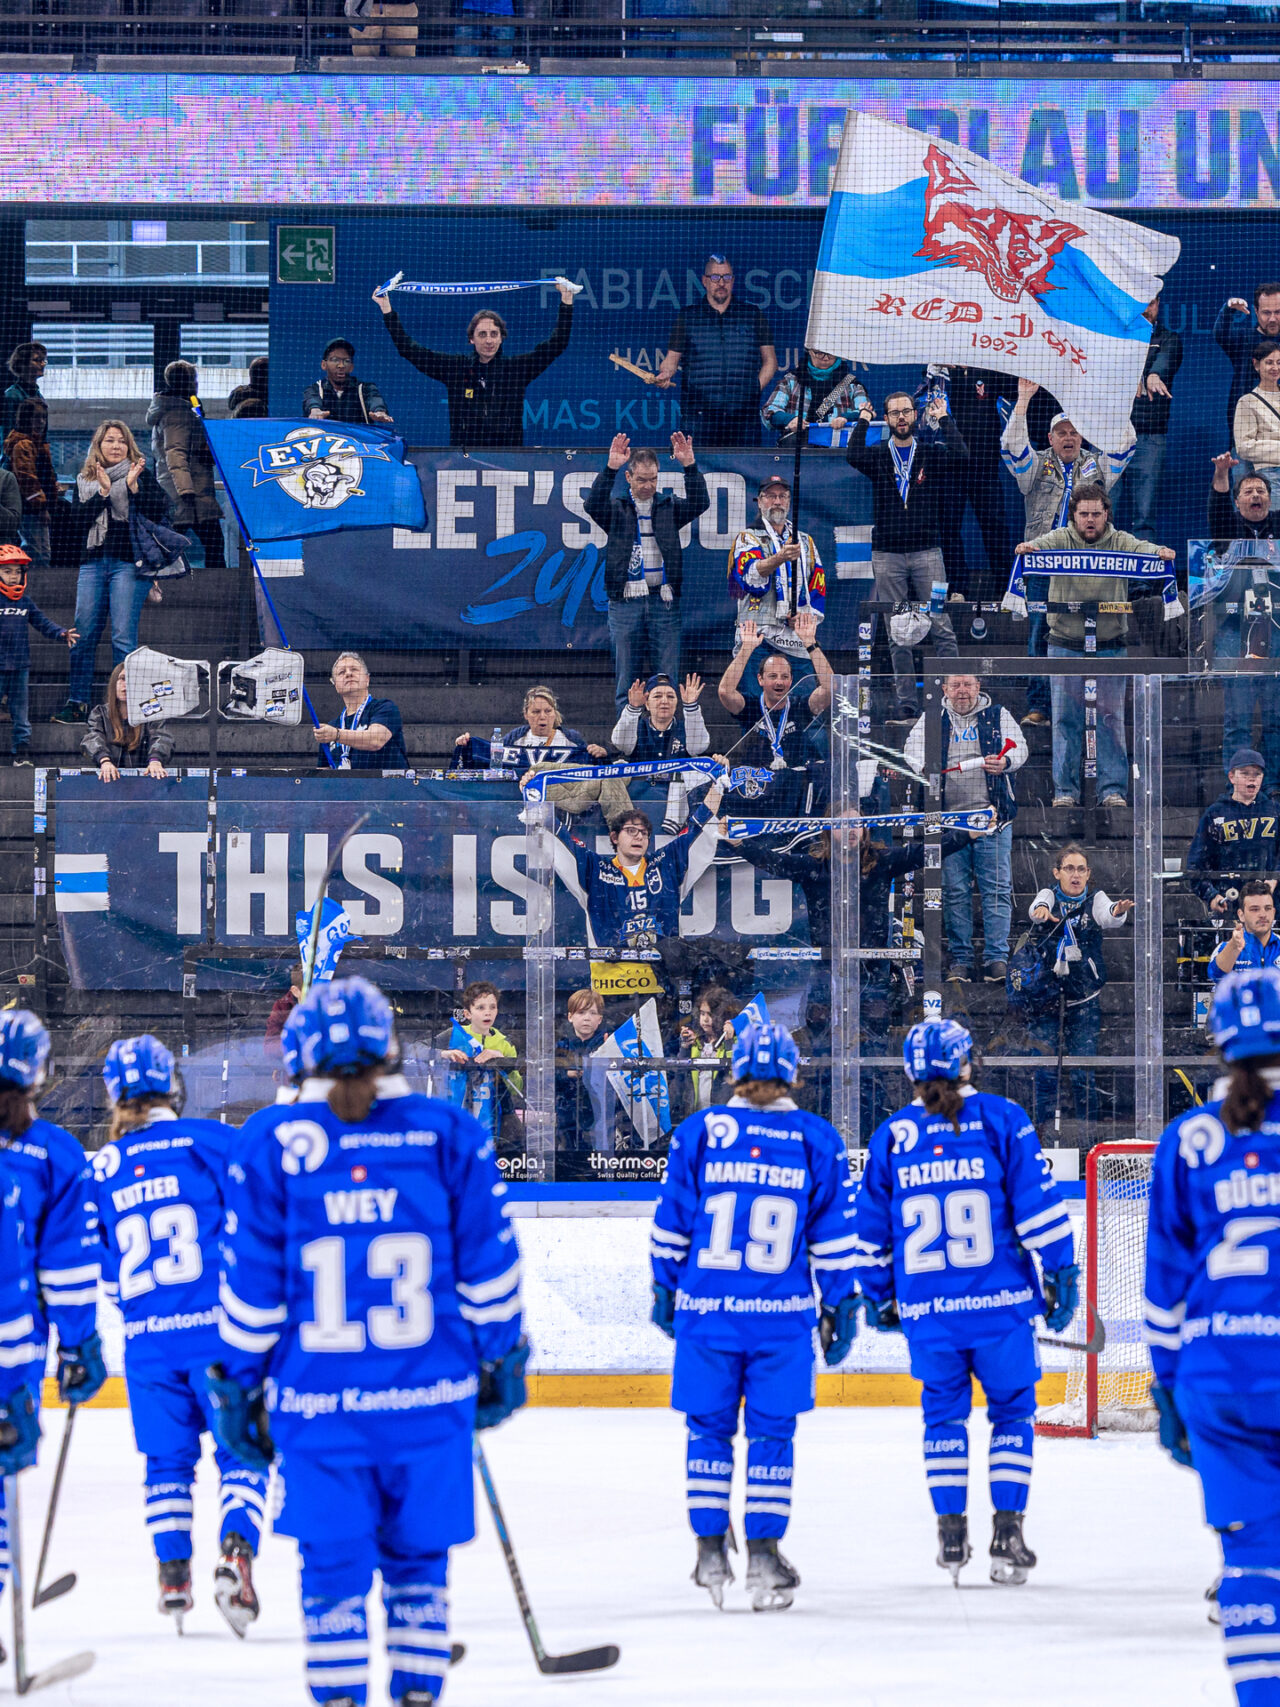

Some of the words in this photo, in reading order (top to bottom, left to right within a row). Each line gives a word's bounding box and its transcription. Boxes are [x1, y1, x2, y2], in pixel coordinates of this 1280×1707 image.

[970, 332, 1019, 357] 1992
[267, 436, 357, 469] EVZ
[1024, 552, 1138, 573] EISSPORTVEREIN
[1143, 558, 1166, 574] ZUG
[501, 745, 571, 767] EVZ
[597, 765, 621, 777] FÜR
[623, 763, 653, 775] BLAU
[1223, 816, 1276, 843] EVZ
[158, 832, 403, 936] THIS
[452, 834, 551, 936] IS
[629, 890, 648, 911] 15
[624, 915, 658, 936] EVZ
[593, 976, 651, 990] CHICCO
[746, 1125, 785, 1141] BEYOND
[597, 1171, 615, 1179] Swiss
[616, 1171, 639, 1180] Quality
[640, 1171, 661, 1179] Coffee
[704, 1161, 806, 1190] MANETSCH
[897, 1156, 985, 1190] FAZOKAS
[111, 1174, 179, 1213] KUTZER
[323, 1188, 398, 1225] WEY
[696, 1190, 799, 1275] 19
[901, 1188, 995, 1275] 29
[114, 1203, 203, 1300] 23
[300, 1231, 435, 1354] 13
[680, 1295, 723, 1314] Zuger
